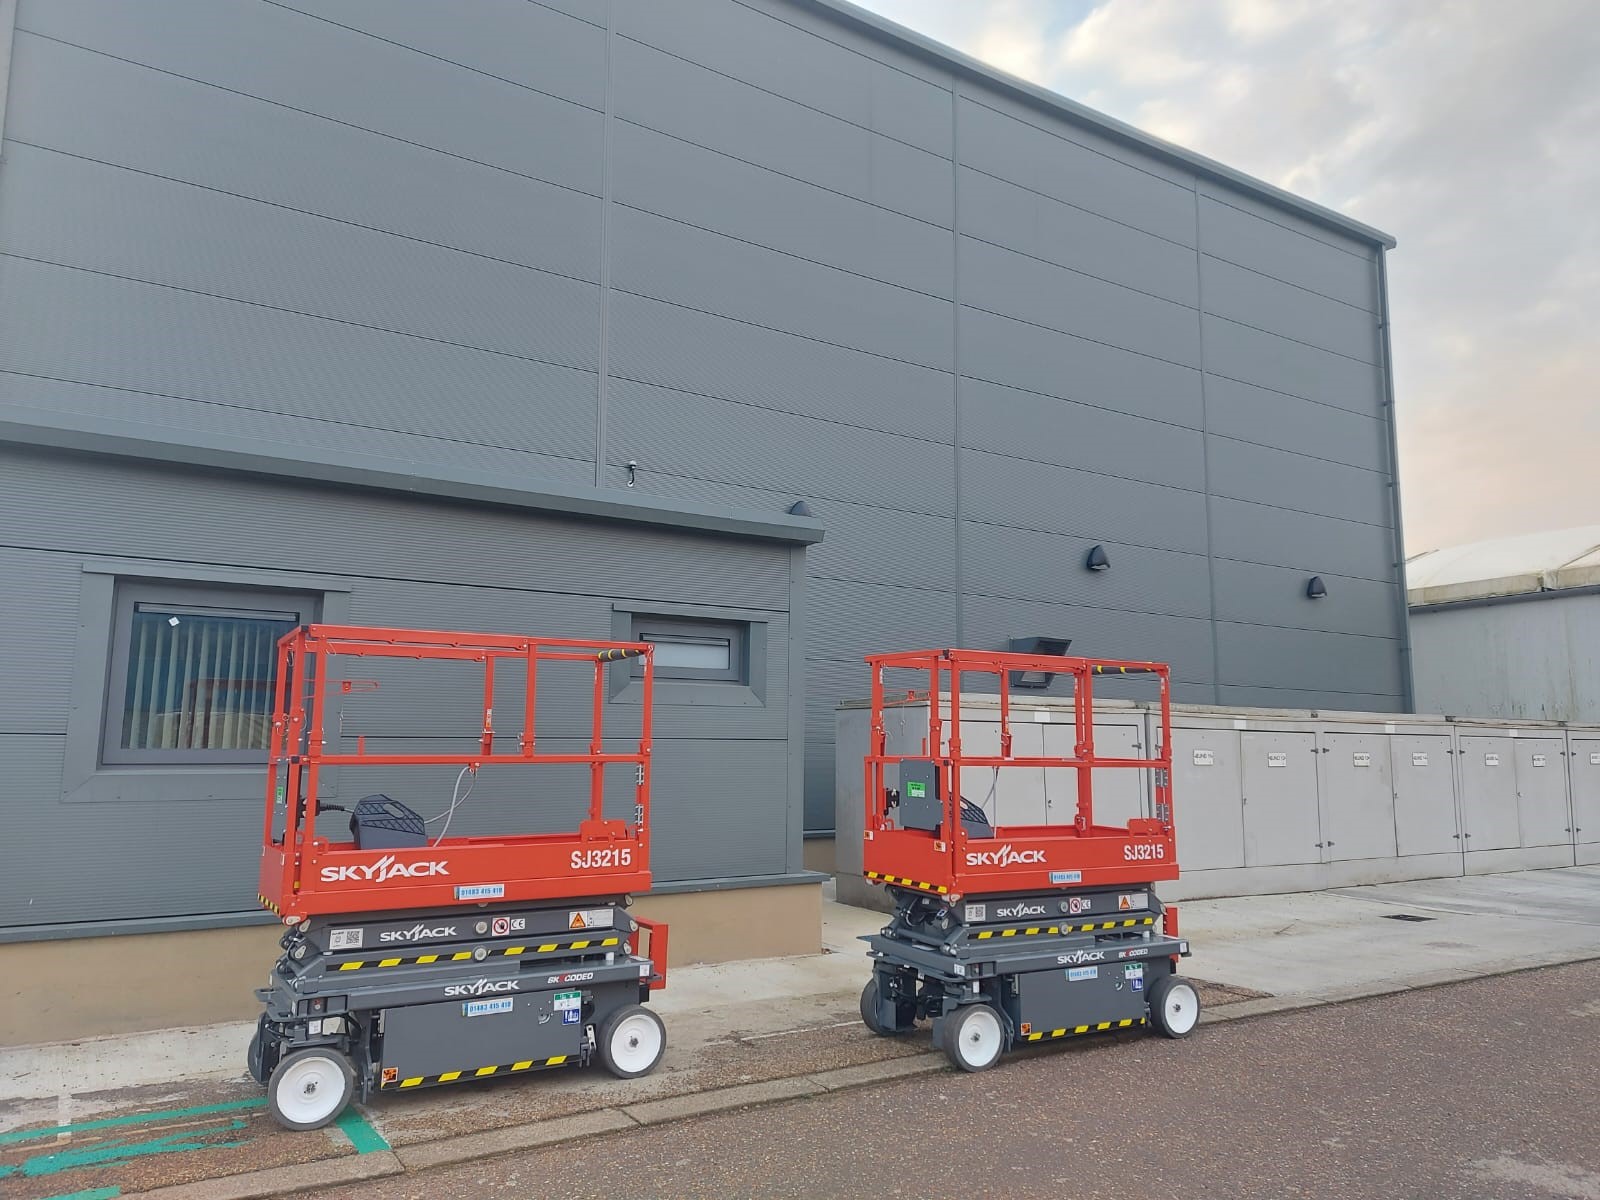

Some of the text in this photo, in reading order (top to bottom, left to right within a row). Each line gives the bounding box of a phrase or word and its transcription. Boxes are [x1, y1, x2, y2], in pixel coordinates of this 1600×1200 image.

[570, 848, 631, 869] SJ3215
[966, 844, 1047, 868] SKYJACK
[1124, 844, 1164, 861] SJ3215
[320, 855, 450, 883] SKYJACK
[996, 902, 1046, 917] SKYJACK
[379, 923, 457, 942] SKYJACK
[1057, 950, 1105, 965] SKYJACK
[444, 978, 520, 996] SKYJACK
